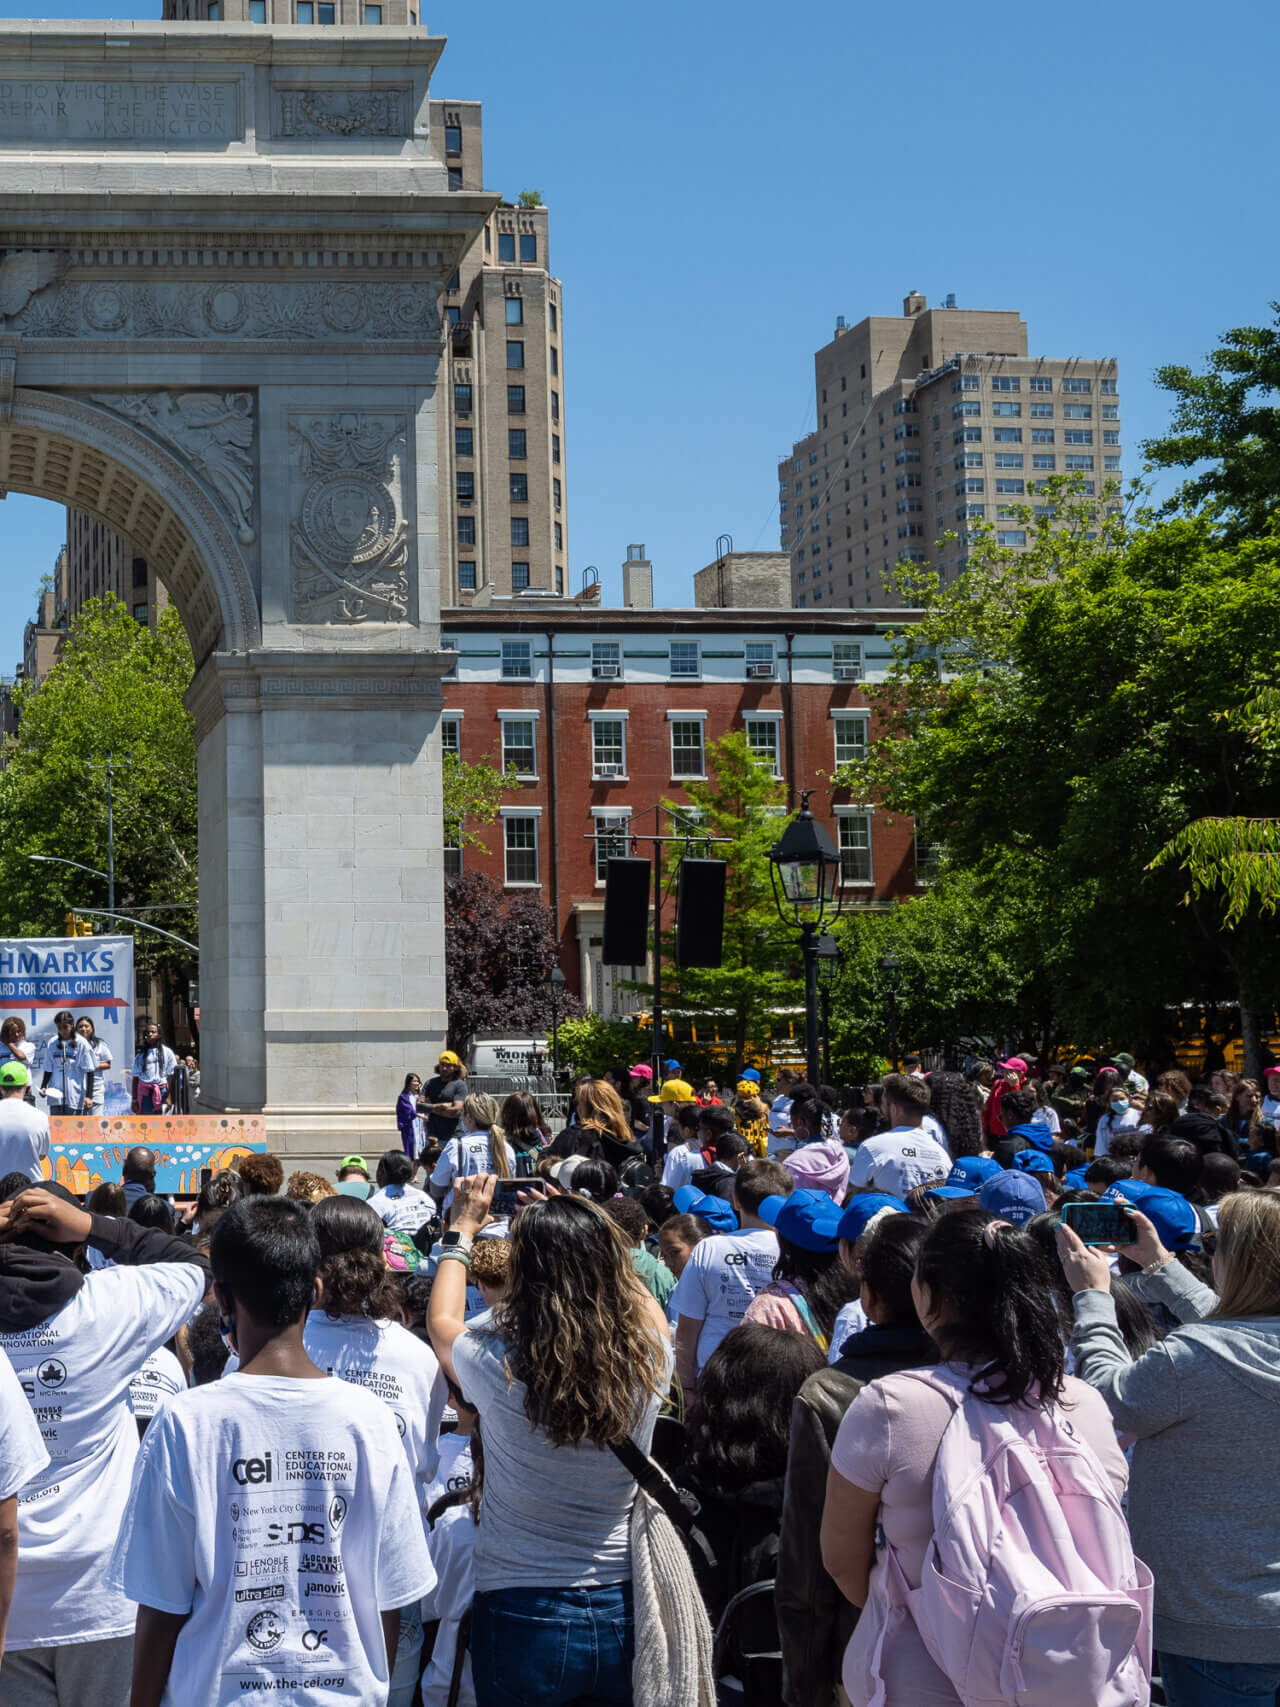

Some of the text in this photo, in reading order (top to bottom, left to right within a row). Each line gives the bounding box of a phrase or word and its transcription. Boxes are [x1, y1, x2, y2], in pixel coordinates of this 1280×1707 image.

[23, 85, 49, 99] TO
[56, 85, 120, 100] WHICH
[128, 86, 169, 100] THE
[177, 86, 225, 100] WISE
[104, 103, 144, 117] THE
[156, 103, 225, 118] EVENT
[86, 119, 226, 135] WASHINGTON
[18, 982, 36, 995] FOR
[40, 982, 72, 995] SOCIAL
[74, 980, 111, 994] CHANGE
[724, 1251, 748, 1267] cei
[0, 1339, 54, 1348] NNOVATION
[345, 1369, 397, 1383] CENTER FOR
[232, 1451, 345, 1485] cei CENTER FOR
[286, 1462, 352, 1471] EDUCATIONAL
[286, 1471, 347, 1481] INNOVATION
[243, 1503, 324, 1516] New York City Council
[250, 1556, 288, 1568] LENOBLE
[250, 1565, 289, 1576] LUMBER
[236, 1586, 284, 1602] ultra site
[240, 1677, 344, 1691] www.the-cei.org
